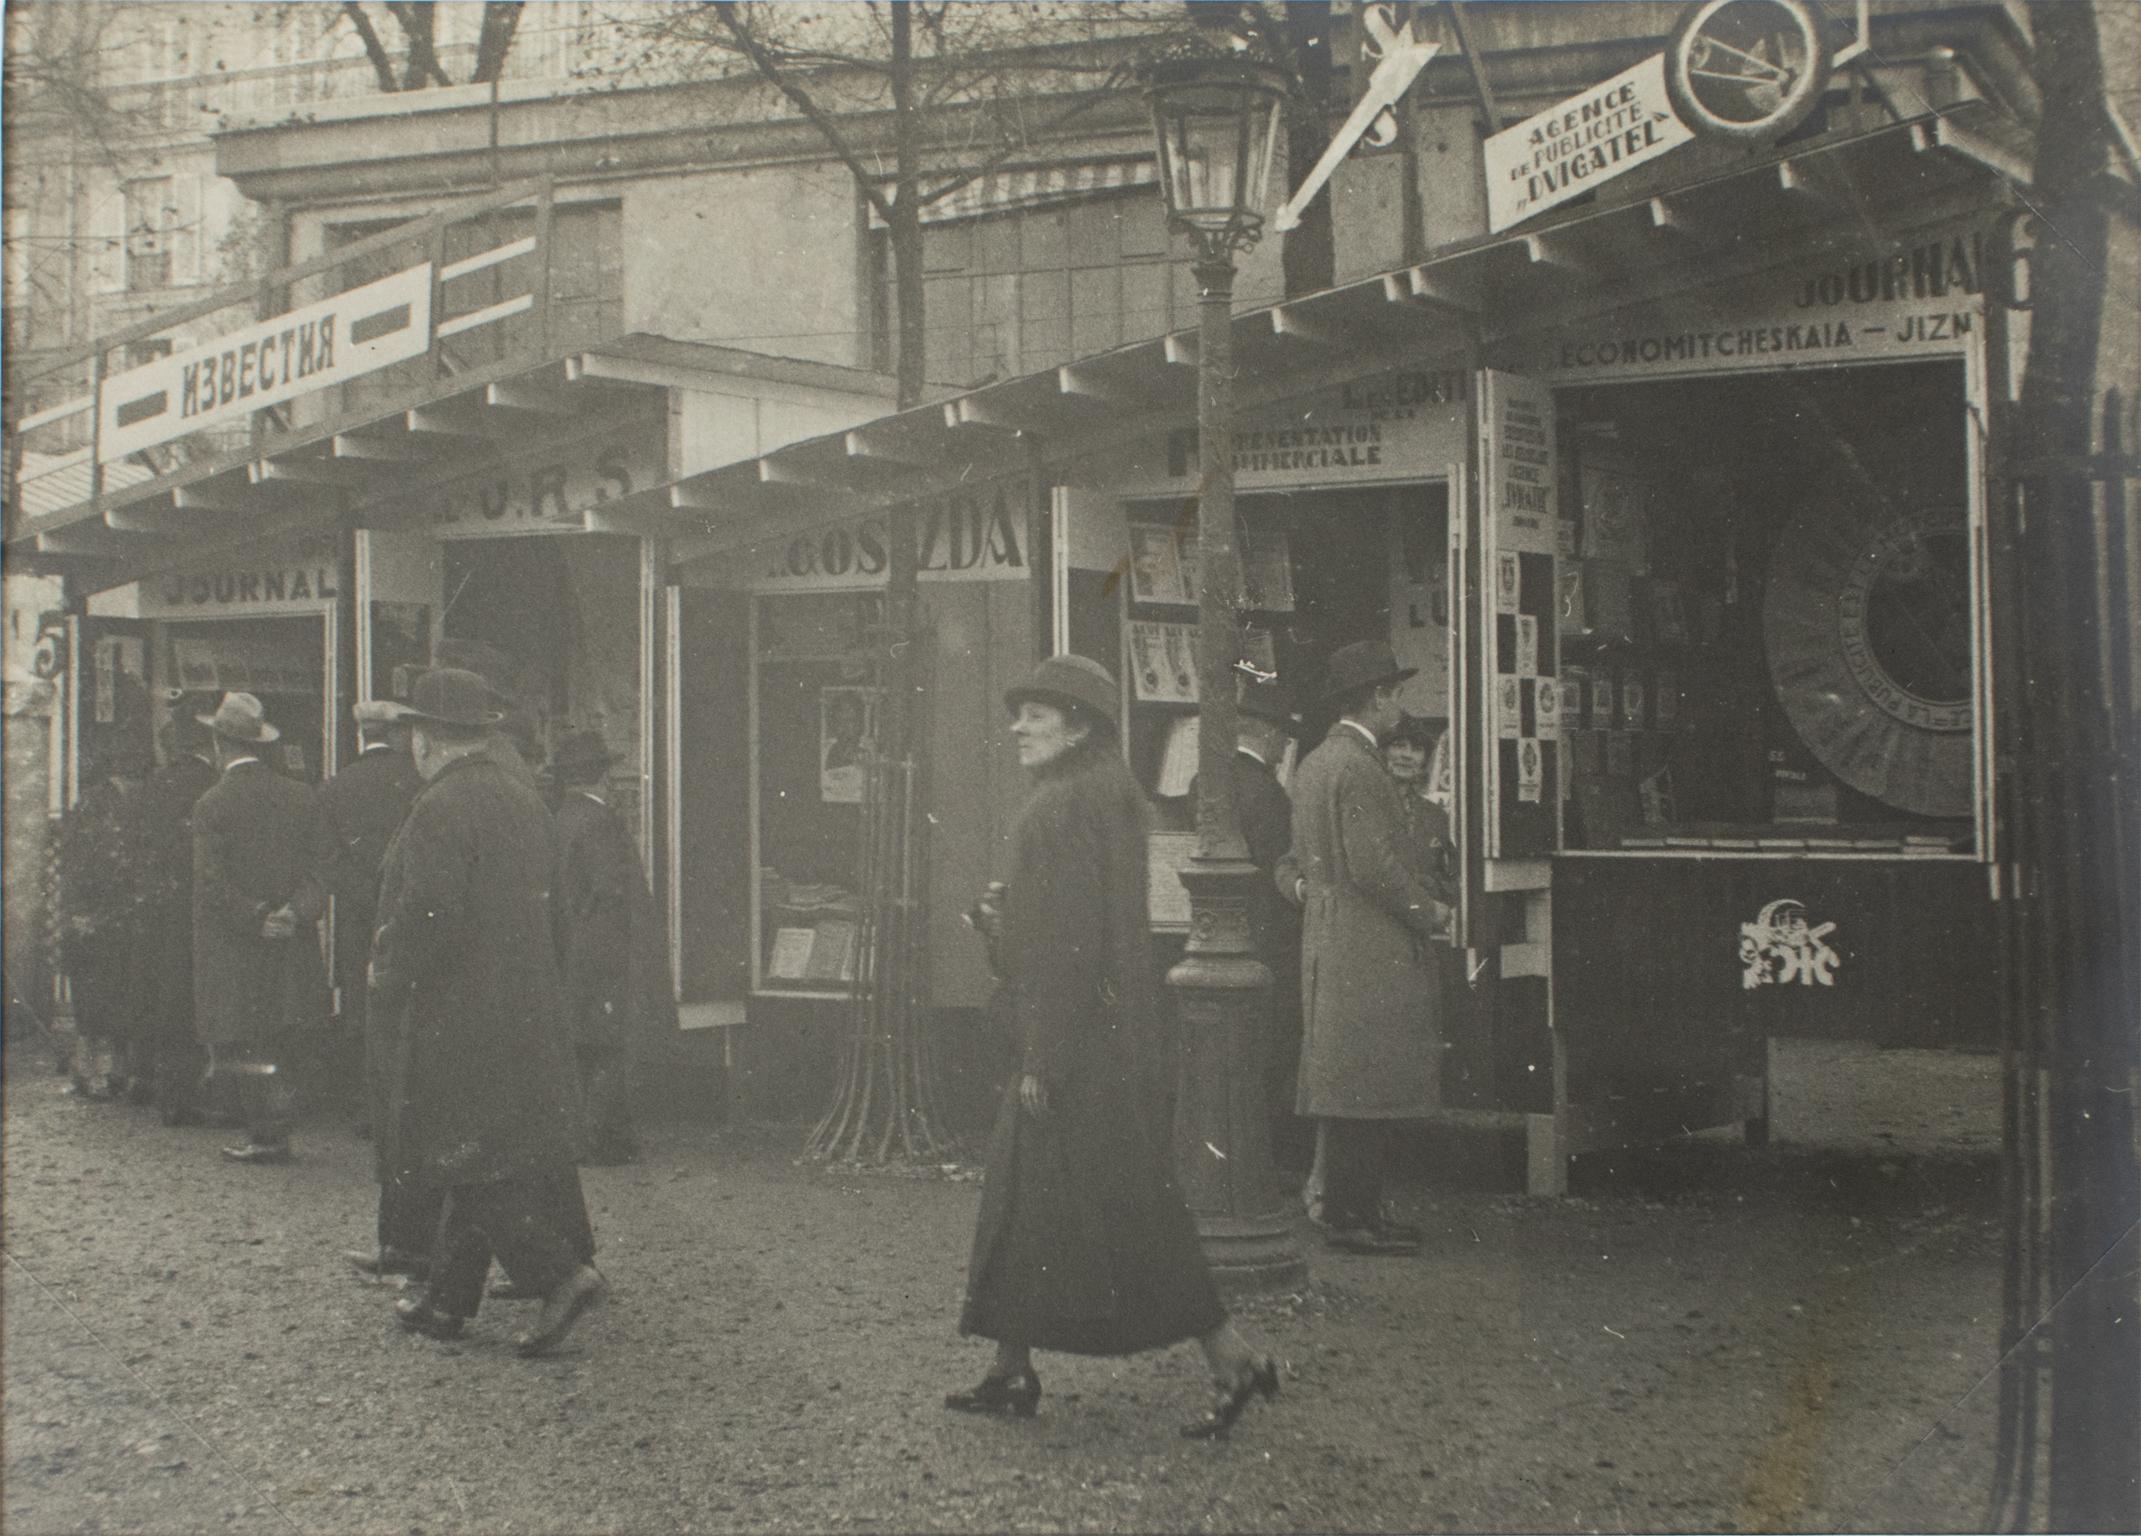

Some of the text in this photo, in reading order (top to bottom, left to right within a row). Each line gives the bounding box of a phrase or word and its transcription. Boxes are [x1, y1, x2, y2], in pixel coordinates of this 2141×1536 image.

[1529, 81, 1635, 146] AGENCE
[1534, 101, 1644, 170] PUBLICITE
[182, 313, 336, 419] ИЗВЕСТИЯ
[167, 568, 338, 605] JOURNAL
